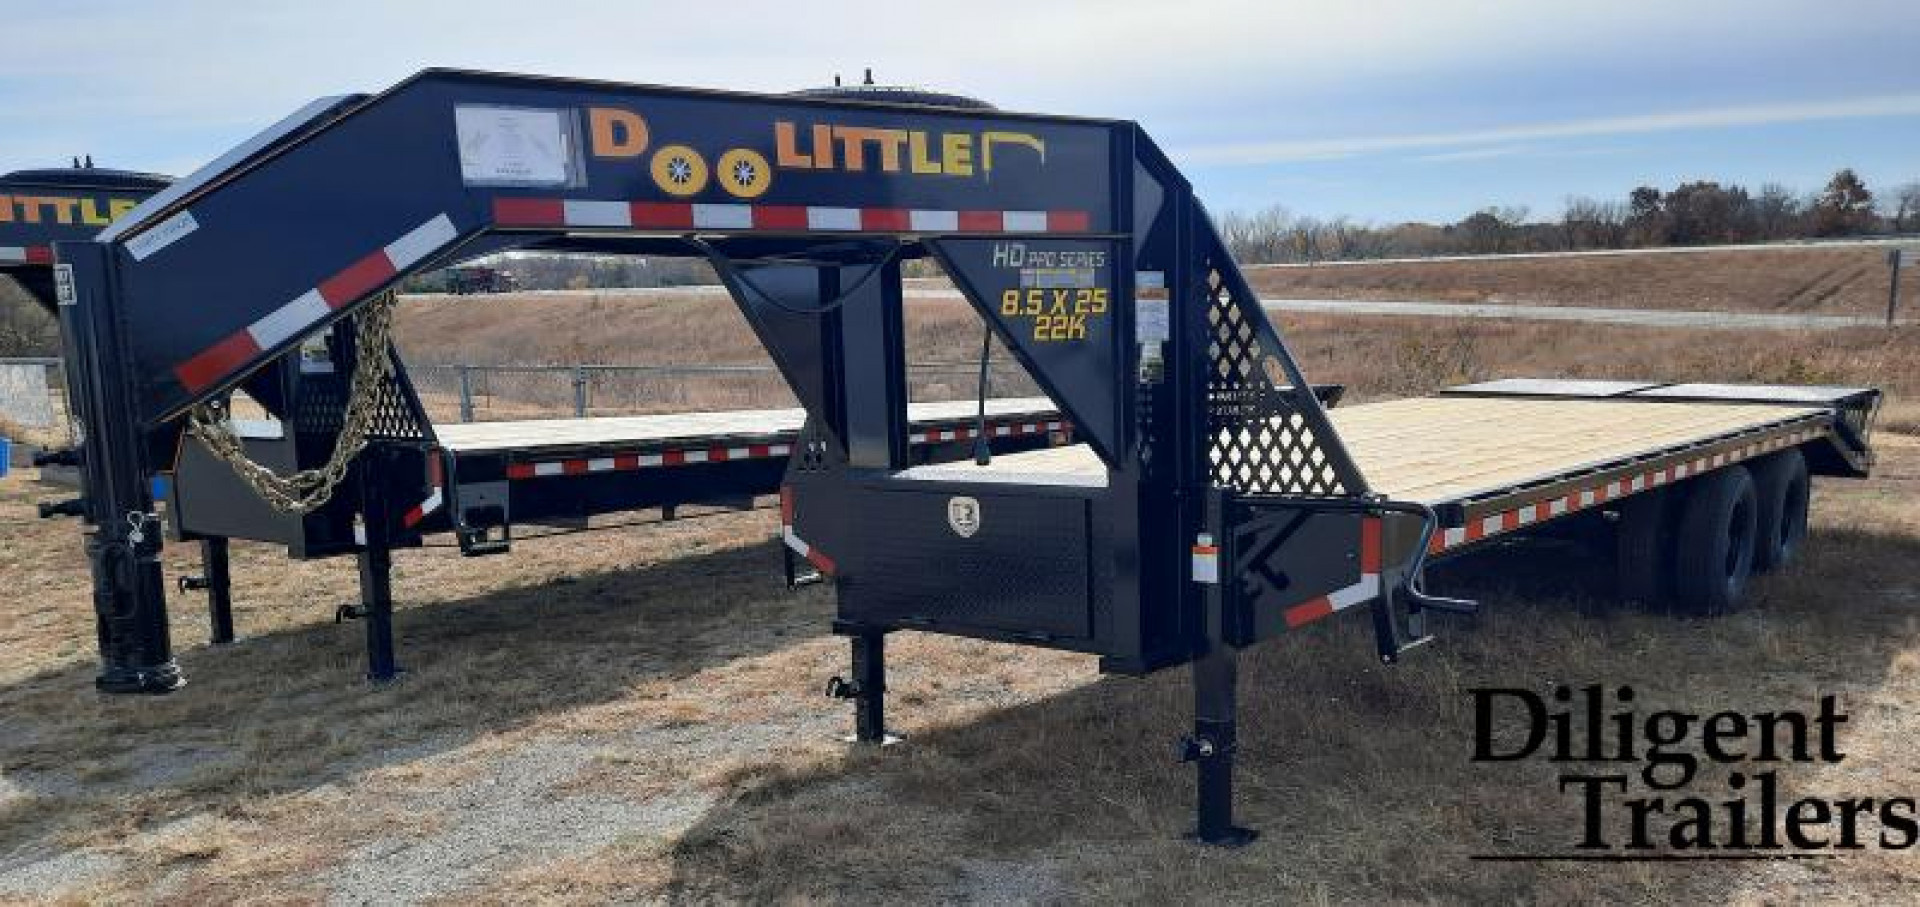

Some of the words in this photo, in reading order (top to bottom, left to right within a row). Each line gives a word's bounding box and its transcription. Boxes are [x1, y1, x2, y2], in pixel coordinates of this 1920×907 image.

[1001, 289, 1044, 315] 8.5
[1075, 288, 1107, 313] 25
[1034, 314, 1086, 339] 22K
